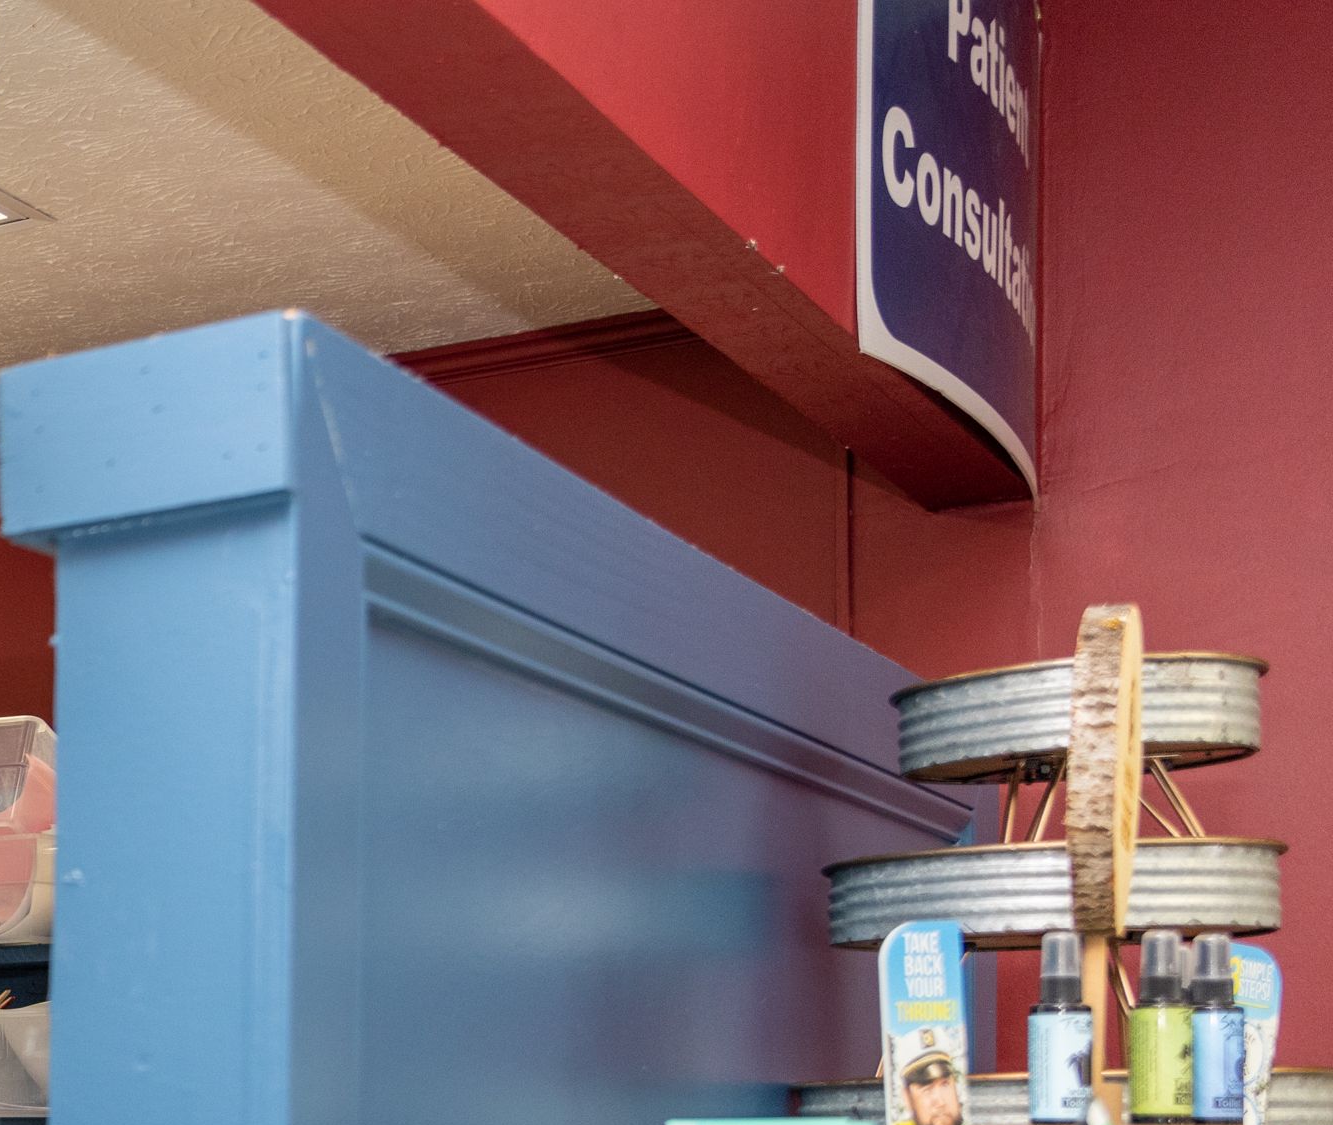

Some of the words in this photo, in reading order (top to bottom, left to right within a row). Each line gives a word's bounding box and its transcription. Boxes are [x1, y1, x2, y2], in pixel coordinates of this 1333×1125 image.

[902, 931, 940, 954] TAKE
[904, 954, 943, 975] BACK
[1239, 961, 1274, 982] SIMPLE
[905, 976, 945, 998] YOUR
